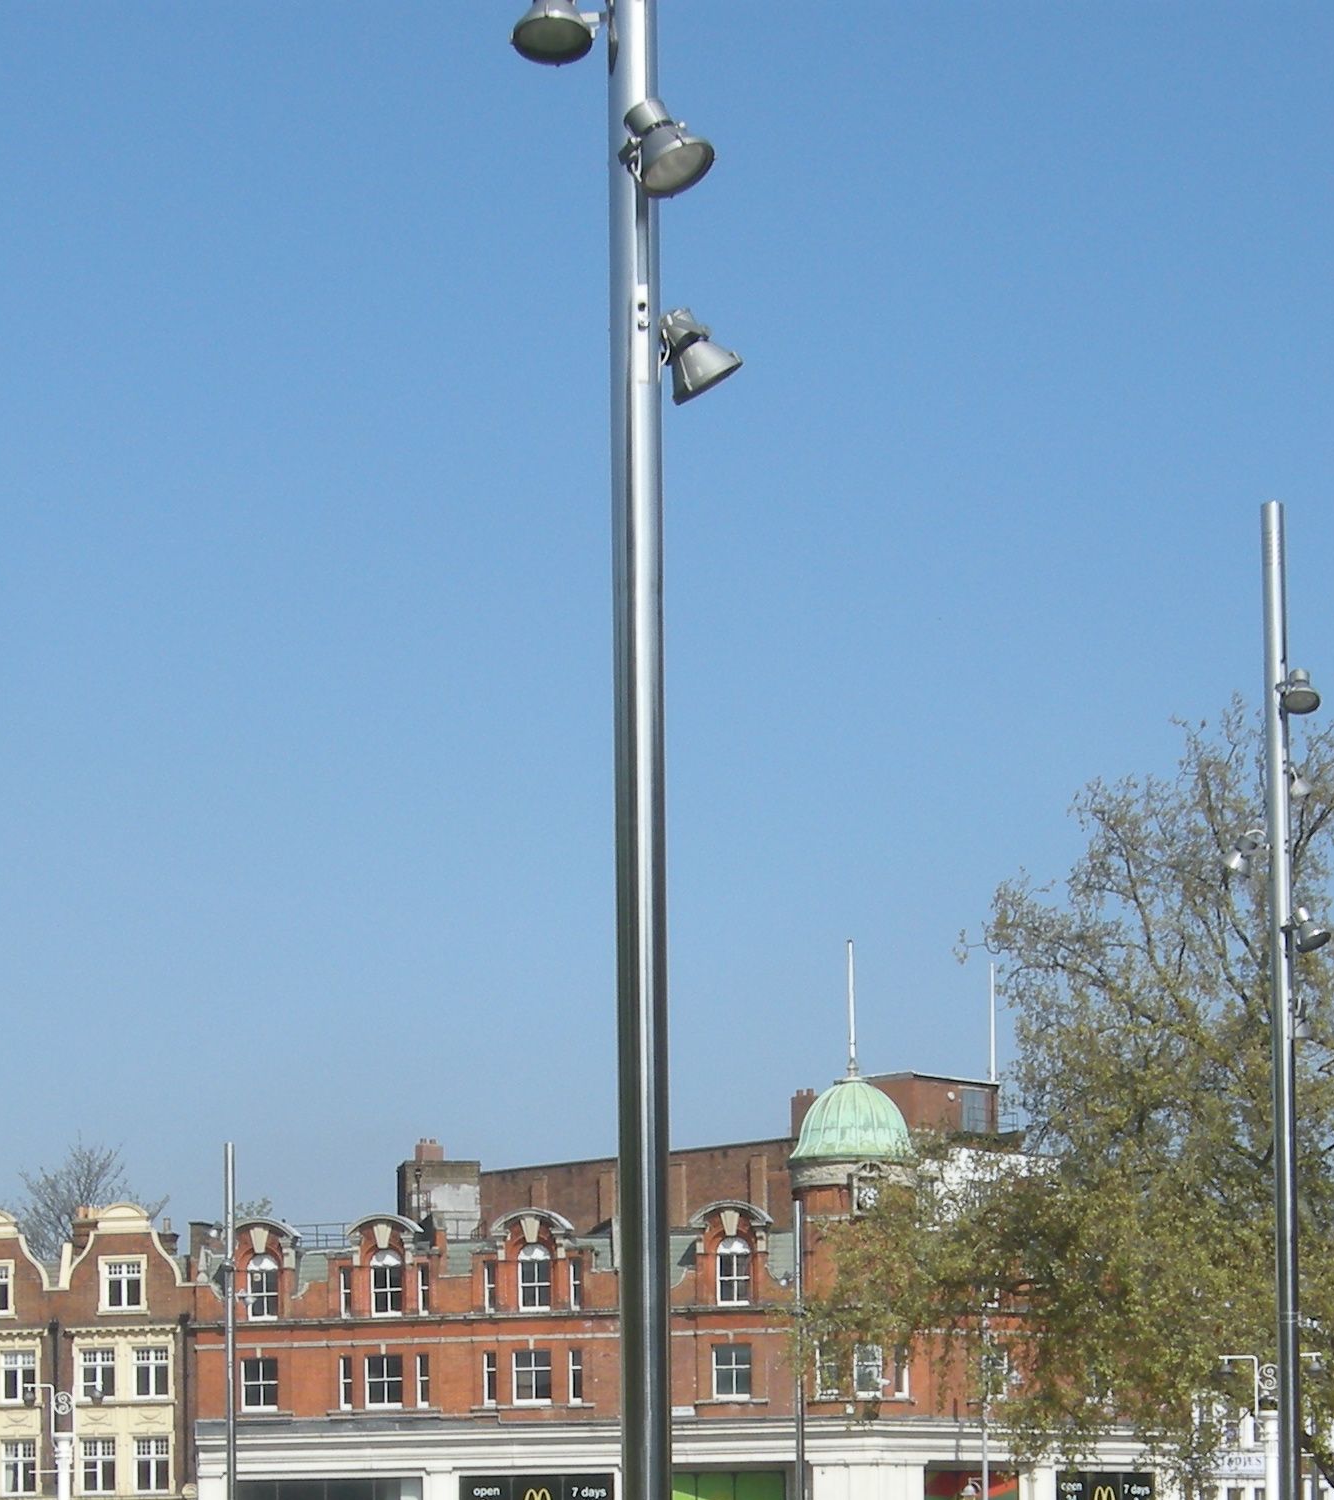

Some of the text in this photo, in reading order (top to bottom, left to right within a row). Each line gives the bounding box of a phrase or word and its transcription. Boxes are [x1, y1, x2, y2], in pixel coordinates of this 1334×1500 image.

[473, 1487, 500, 1497] open
[571, 1486, 607, 1499] 7 days
[1123, 1484, 1151, 1496] 7 days
